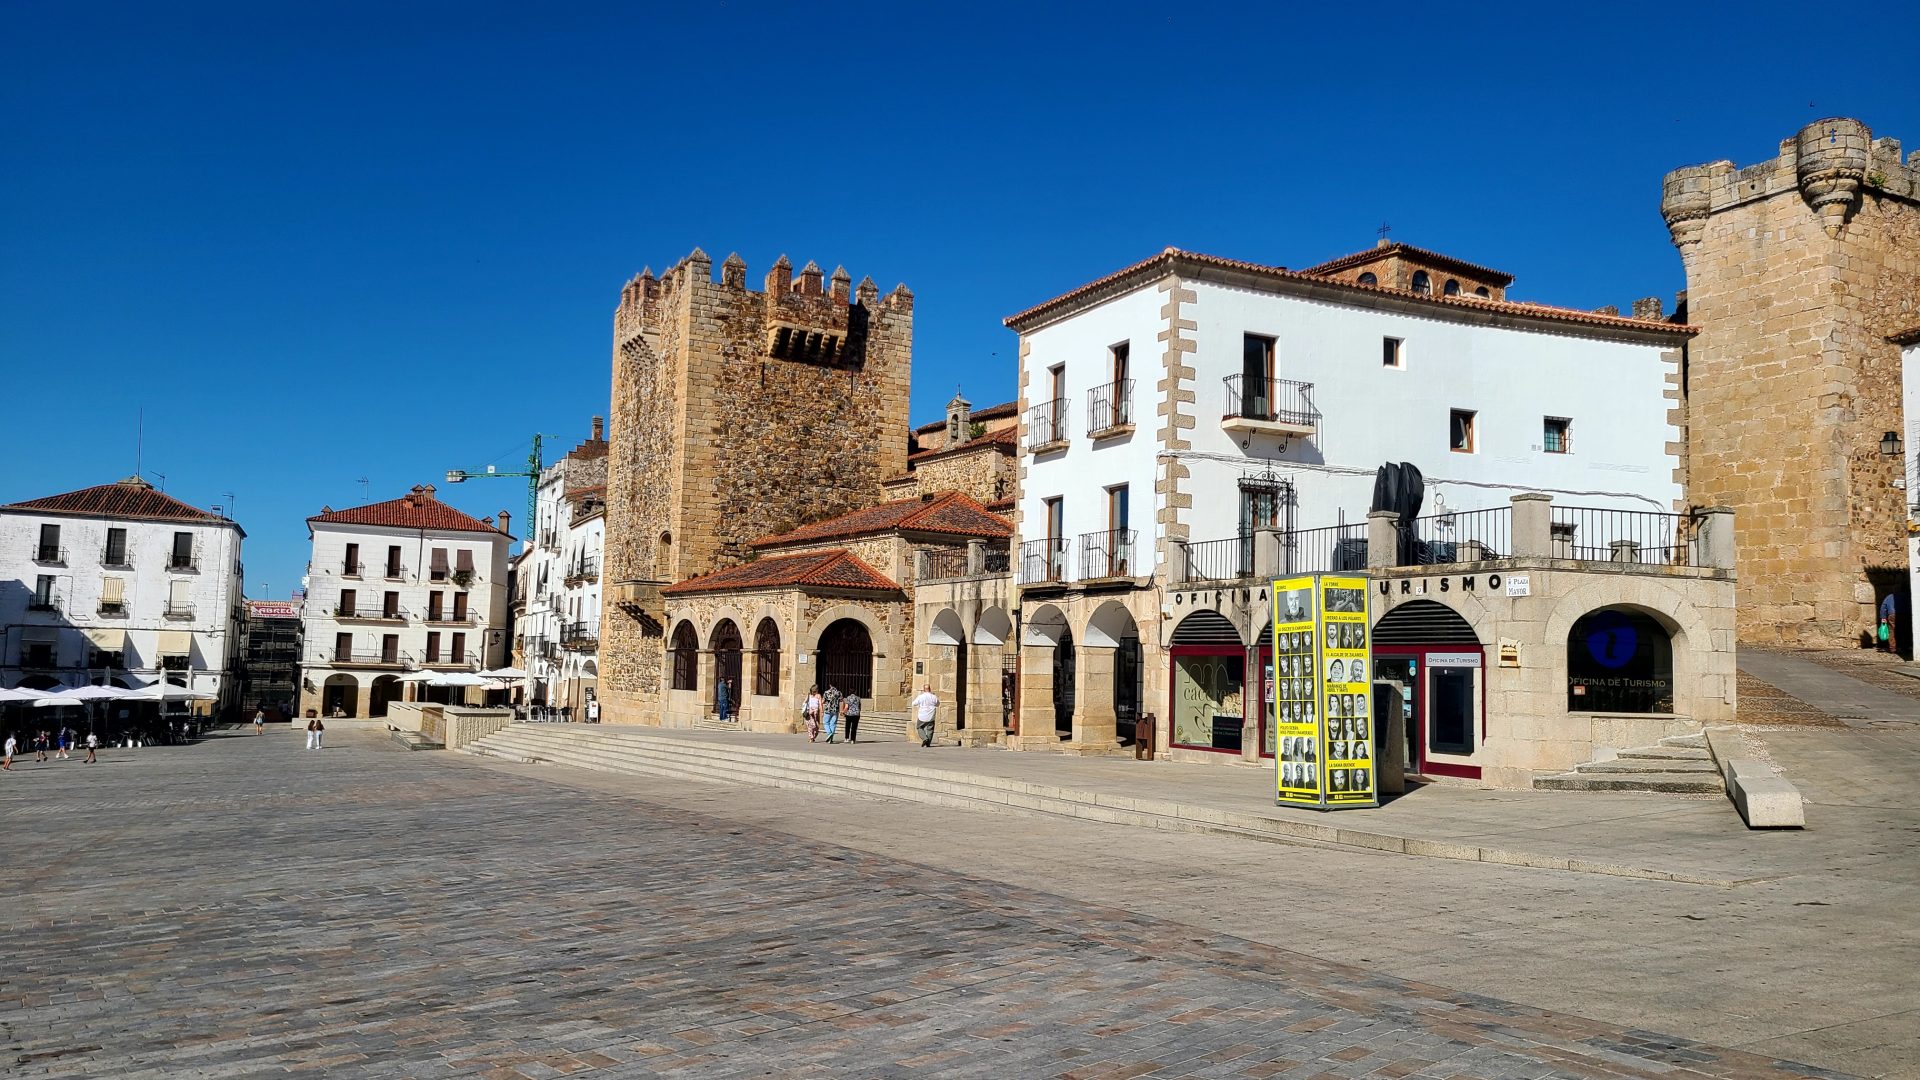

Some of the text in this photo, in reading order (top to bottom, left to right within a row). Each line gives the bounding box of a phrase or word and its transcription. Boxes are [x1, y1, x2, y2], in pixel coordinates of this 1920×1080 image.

[1175, 574, 1501, 605] OFICINA URISMO
[1509, 587, 1527, 595] MAYOR
[1608, 678, 1620, 687] DE
[1624, 678, 1666, 688] TURISMO
